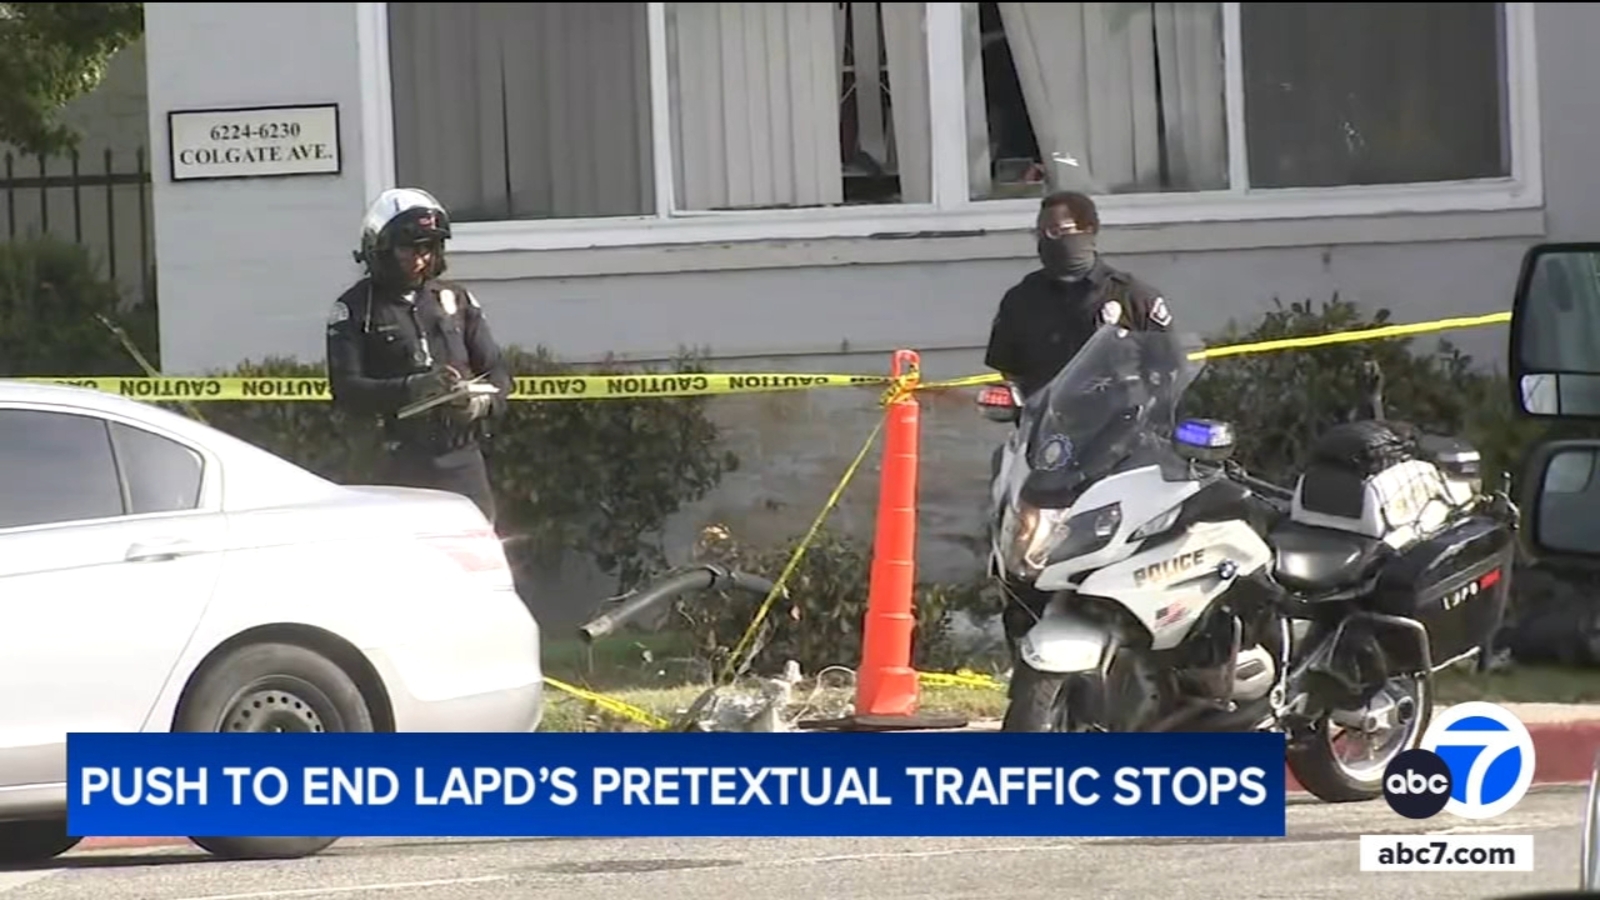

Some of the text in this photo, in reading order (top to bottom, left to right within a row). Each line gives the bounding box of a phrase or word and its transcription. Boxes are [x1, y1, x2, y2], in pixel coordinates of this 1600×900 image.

[210, 122, 301, 141] 6224-6230
[179, 143, 334, 165] COLGATE AVE.
[119, 379, 331, 397] AUTION CAUTION
[510, 378, 587, 396] CAUTI
[607, 375, 709, 394] CAUTION
[728, 375, 830, 390] CAUTION
[1132, 548, 1206, 588] POLICE
